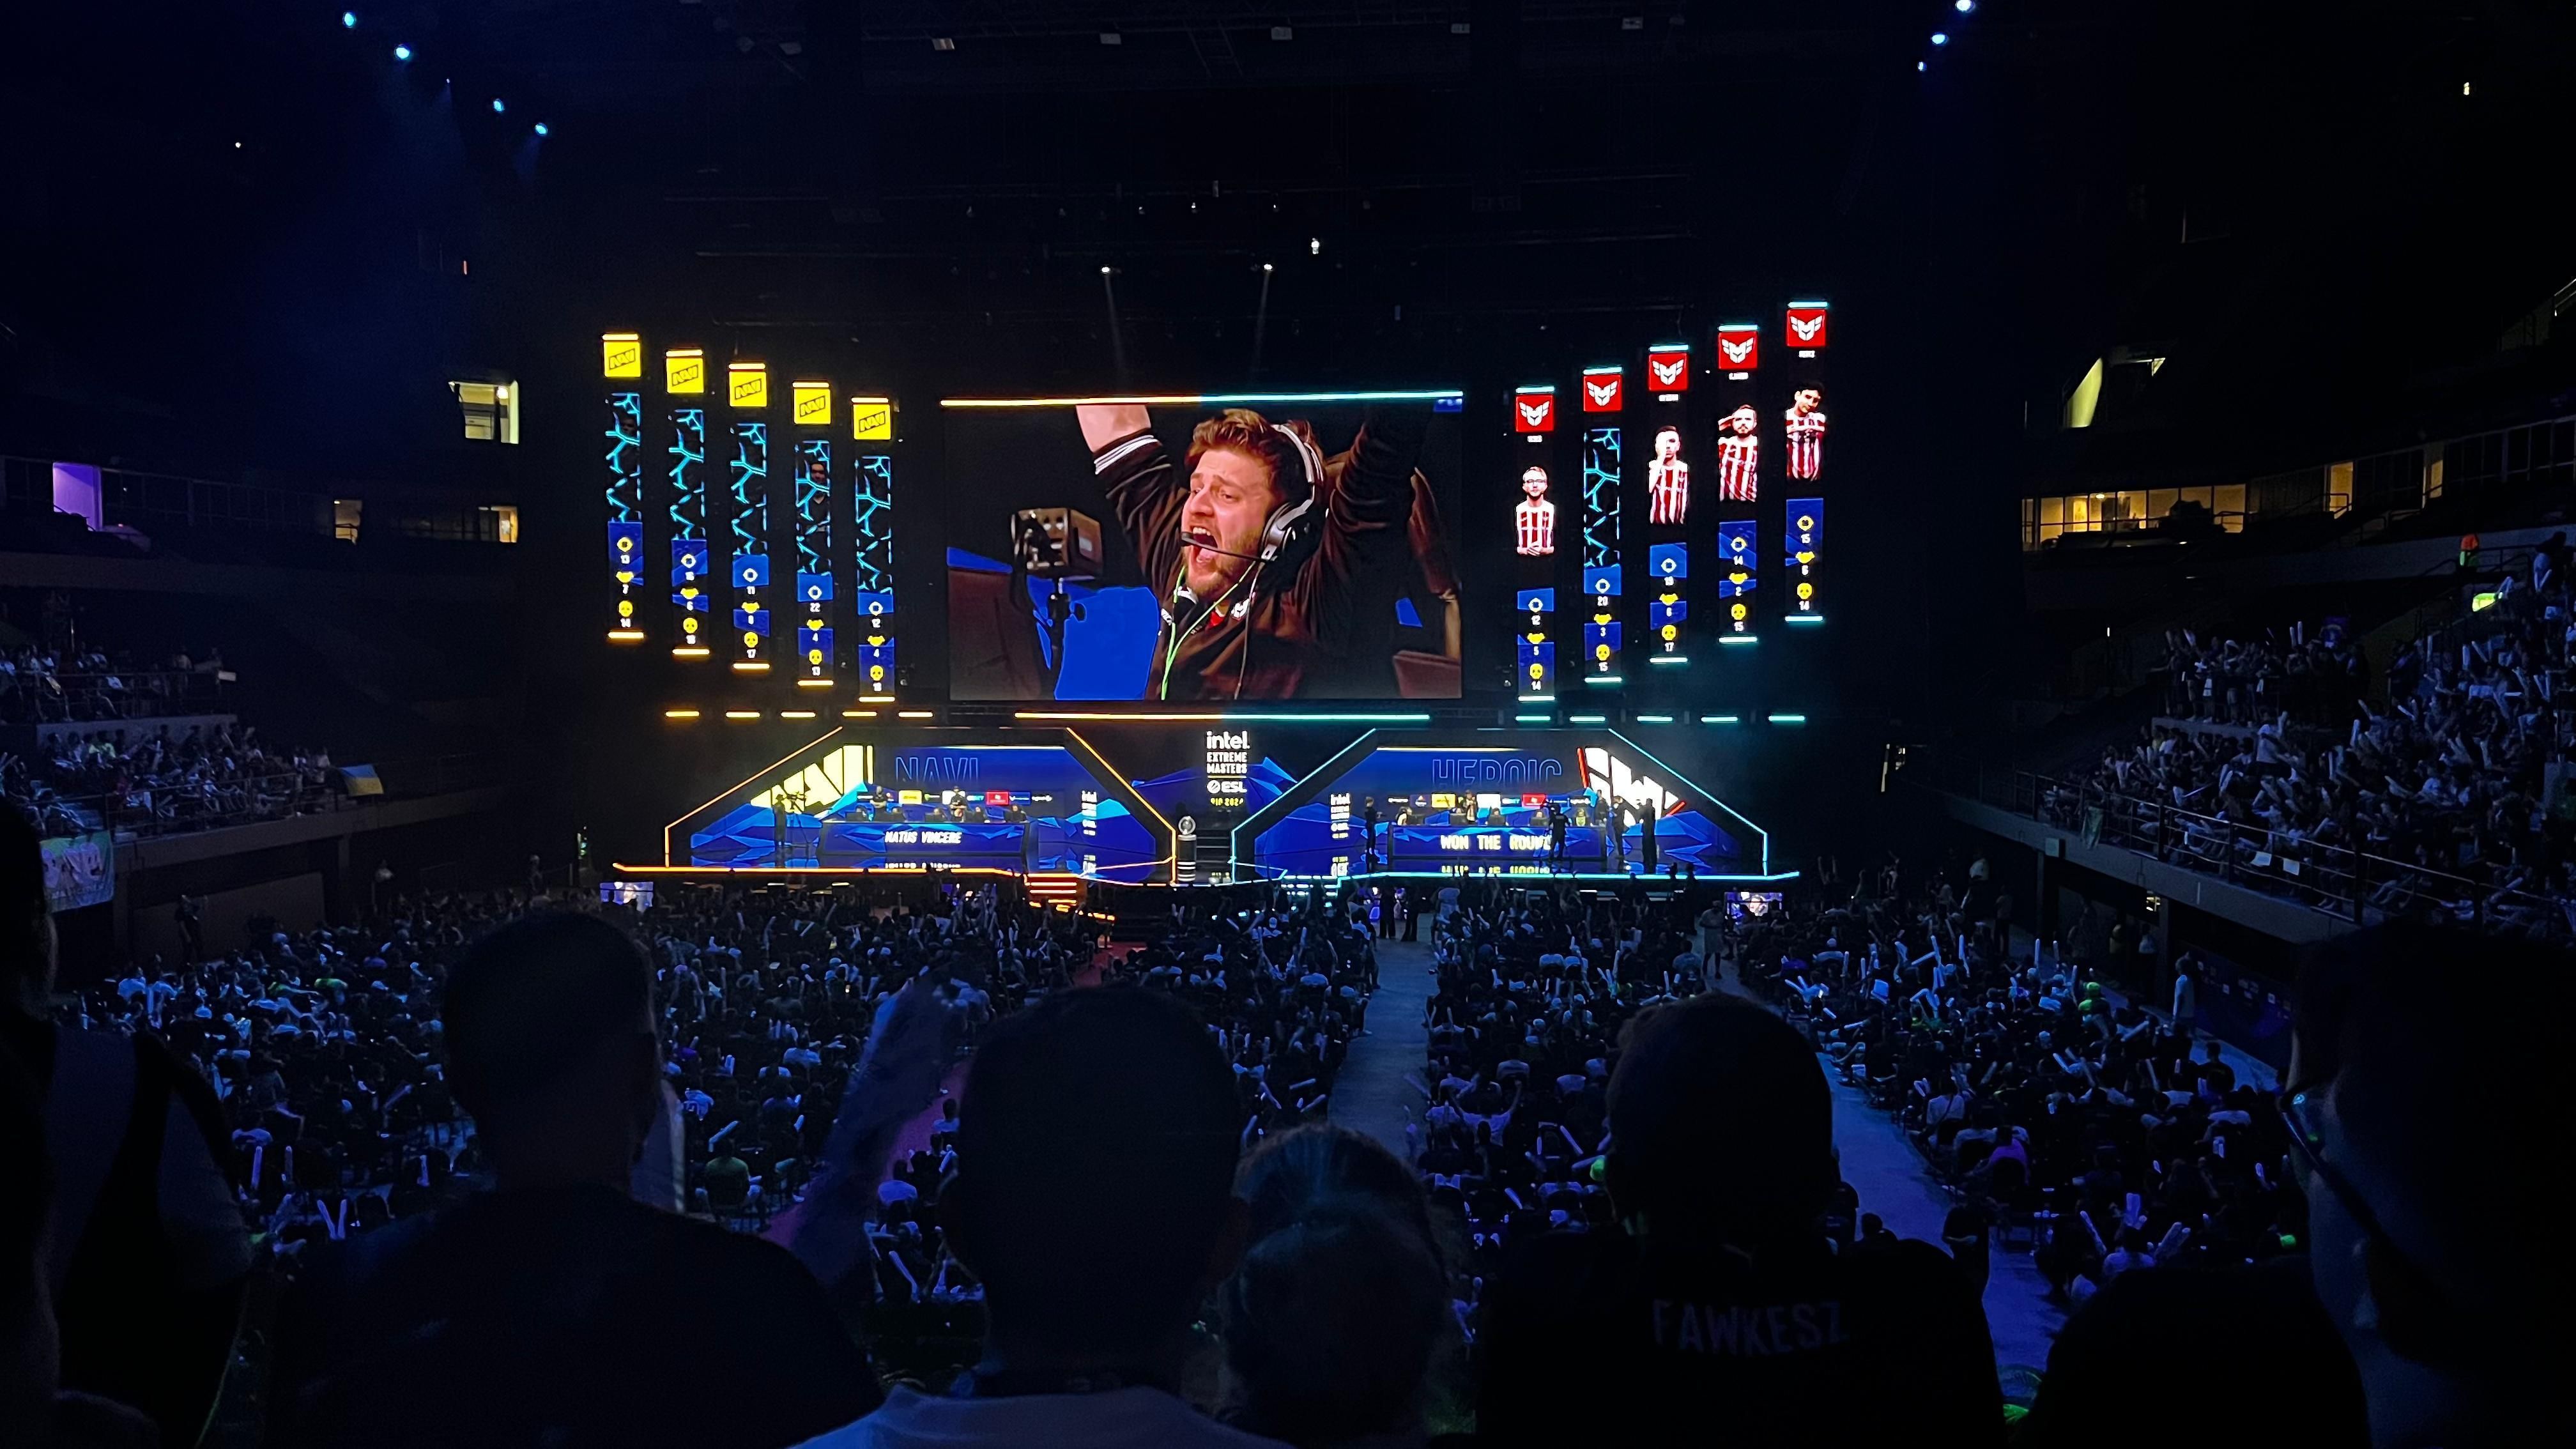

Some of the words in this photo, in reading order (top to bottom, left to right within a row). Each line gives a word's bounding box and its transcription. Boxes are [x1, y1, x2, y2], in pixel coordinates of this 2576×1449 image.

[1801, 533, 1810, 543] 15
[1734, 556, 1743, 565] 14
[1736, 586, 1742, 596] 2
[687, 601, 693, 611] 6
[810, 603, 820, 612] 22
[1799, 601, 1809, 610] 14
[872, 618, 880, 627] 12
[1531, 615, 1540, 625] 12
[1600, 627, 1606, 636] 3
[1734, 622, 1744, 631] 15
[1534, 647, 1538, 656] 5
[1665, 642, 1674, 652] 17
[1599, 662, 1608, 671] 15
[1531, 681, 1541, 690] 14
[1206, 752, 1247, 762] EXTREME
[896, 756, 978, 782] NAVI
[1206, 763, 1247, 774] MASTERS
[1432, 759, 1561, 787] HEROIC
[1221, 781, 1247, 793] ESL
[885, 831, 917, 843] NATUS
[921, 831, 962, 843] VINCERE
[1440, 835, 1469, 850] WON
[1477, 835, 1501, 850] THE
